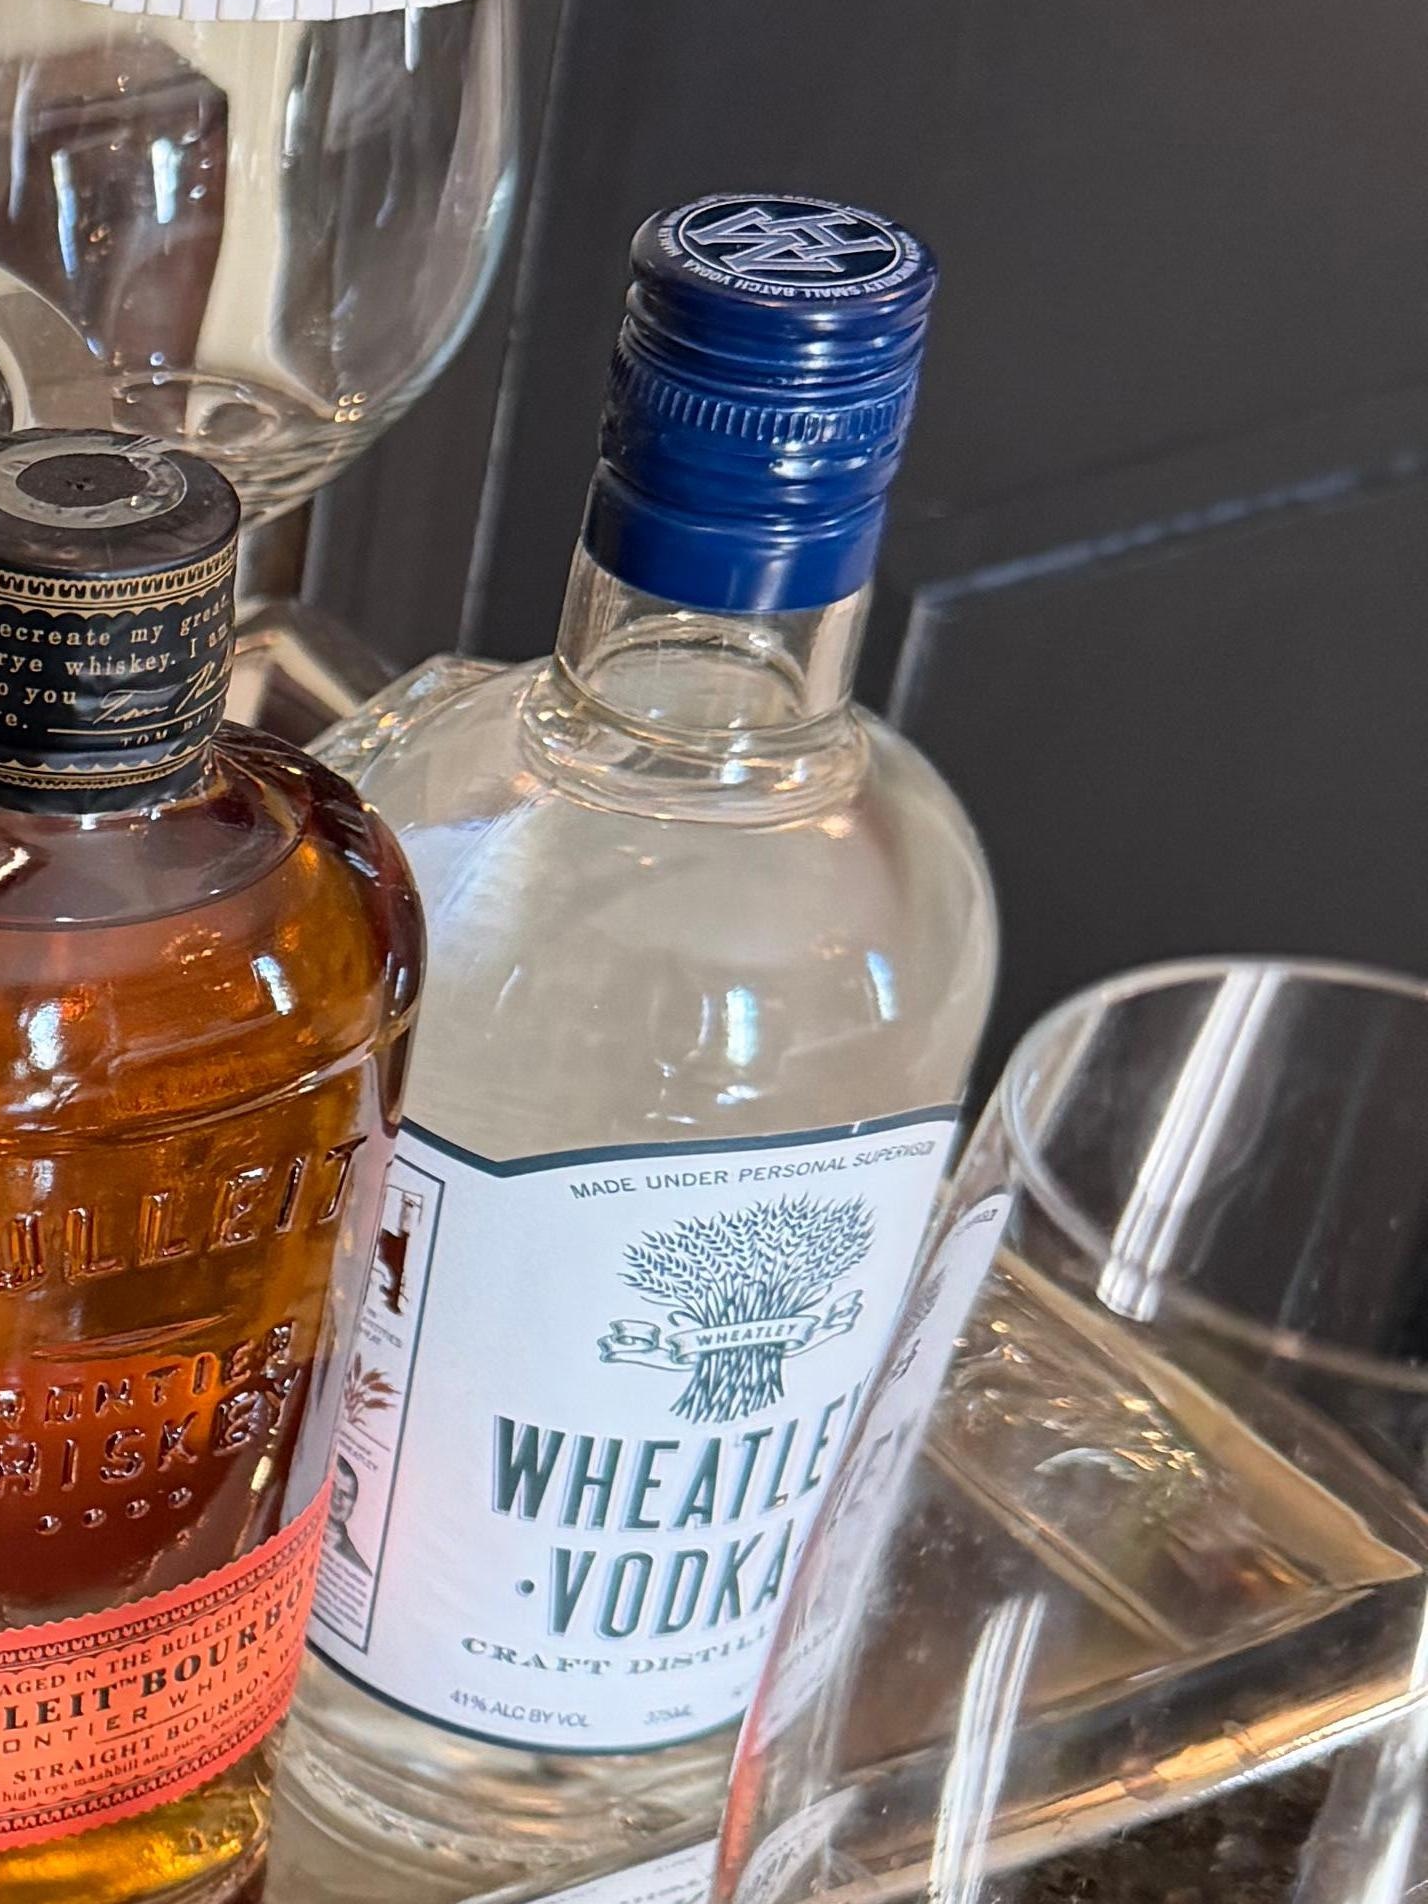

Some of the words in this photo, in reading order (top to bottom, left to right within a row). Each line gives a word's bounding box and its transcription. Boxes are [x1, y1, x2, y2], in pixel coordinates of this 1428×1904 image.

[733, 277, 797, 298] BATCH
[796, 284, 861, 298] SMALL
[130, 621, 165, 648] my
[64, 650, 178, 678] whiskey.
[189, 638, 198, 660] I
[23, 687, 78, 707] you
[569, 1177, 637, 1199] MADE
[646, 1169, 729, 1190] UNDER
[738, 1156, 847, 1182] PERSONAL
[696, 1323, 798, 1347] WHEATLEY
[548, 1518, 795, 1638] VODKA
[75, 1667, 97, 1683] IN
[106, 1650, 152, 1674] THE
[161, 1606, 245, 1658] BULLEIT
[168, 1609, 298, 1709] WHISKEY
[461, 1637, 613, 1676] CRAFT
[12, 1736, 156, 1786] STRAIGHT
[166, 1670, 271, 1742] BOURBON
[491, 1700, 526, 1721] ALC
[528, 1706, 555, 1724] BY
[557, 1710, 590, 1728] VOL
[73, 1759, 139, 1787] mashbill
[143, 1746, 170, 1765] and
